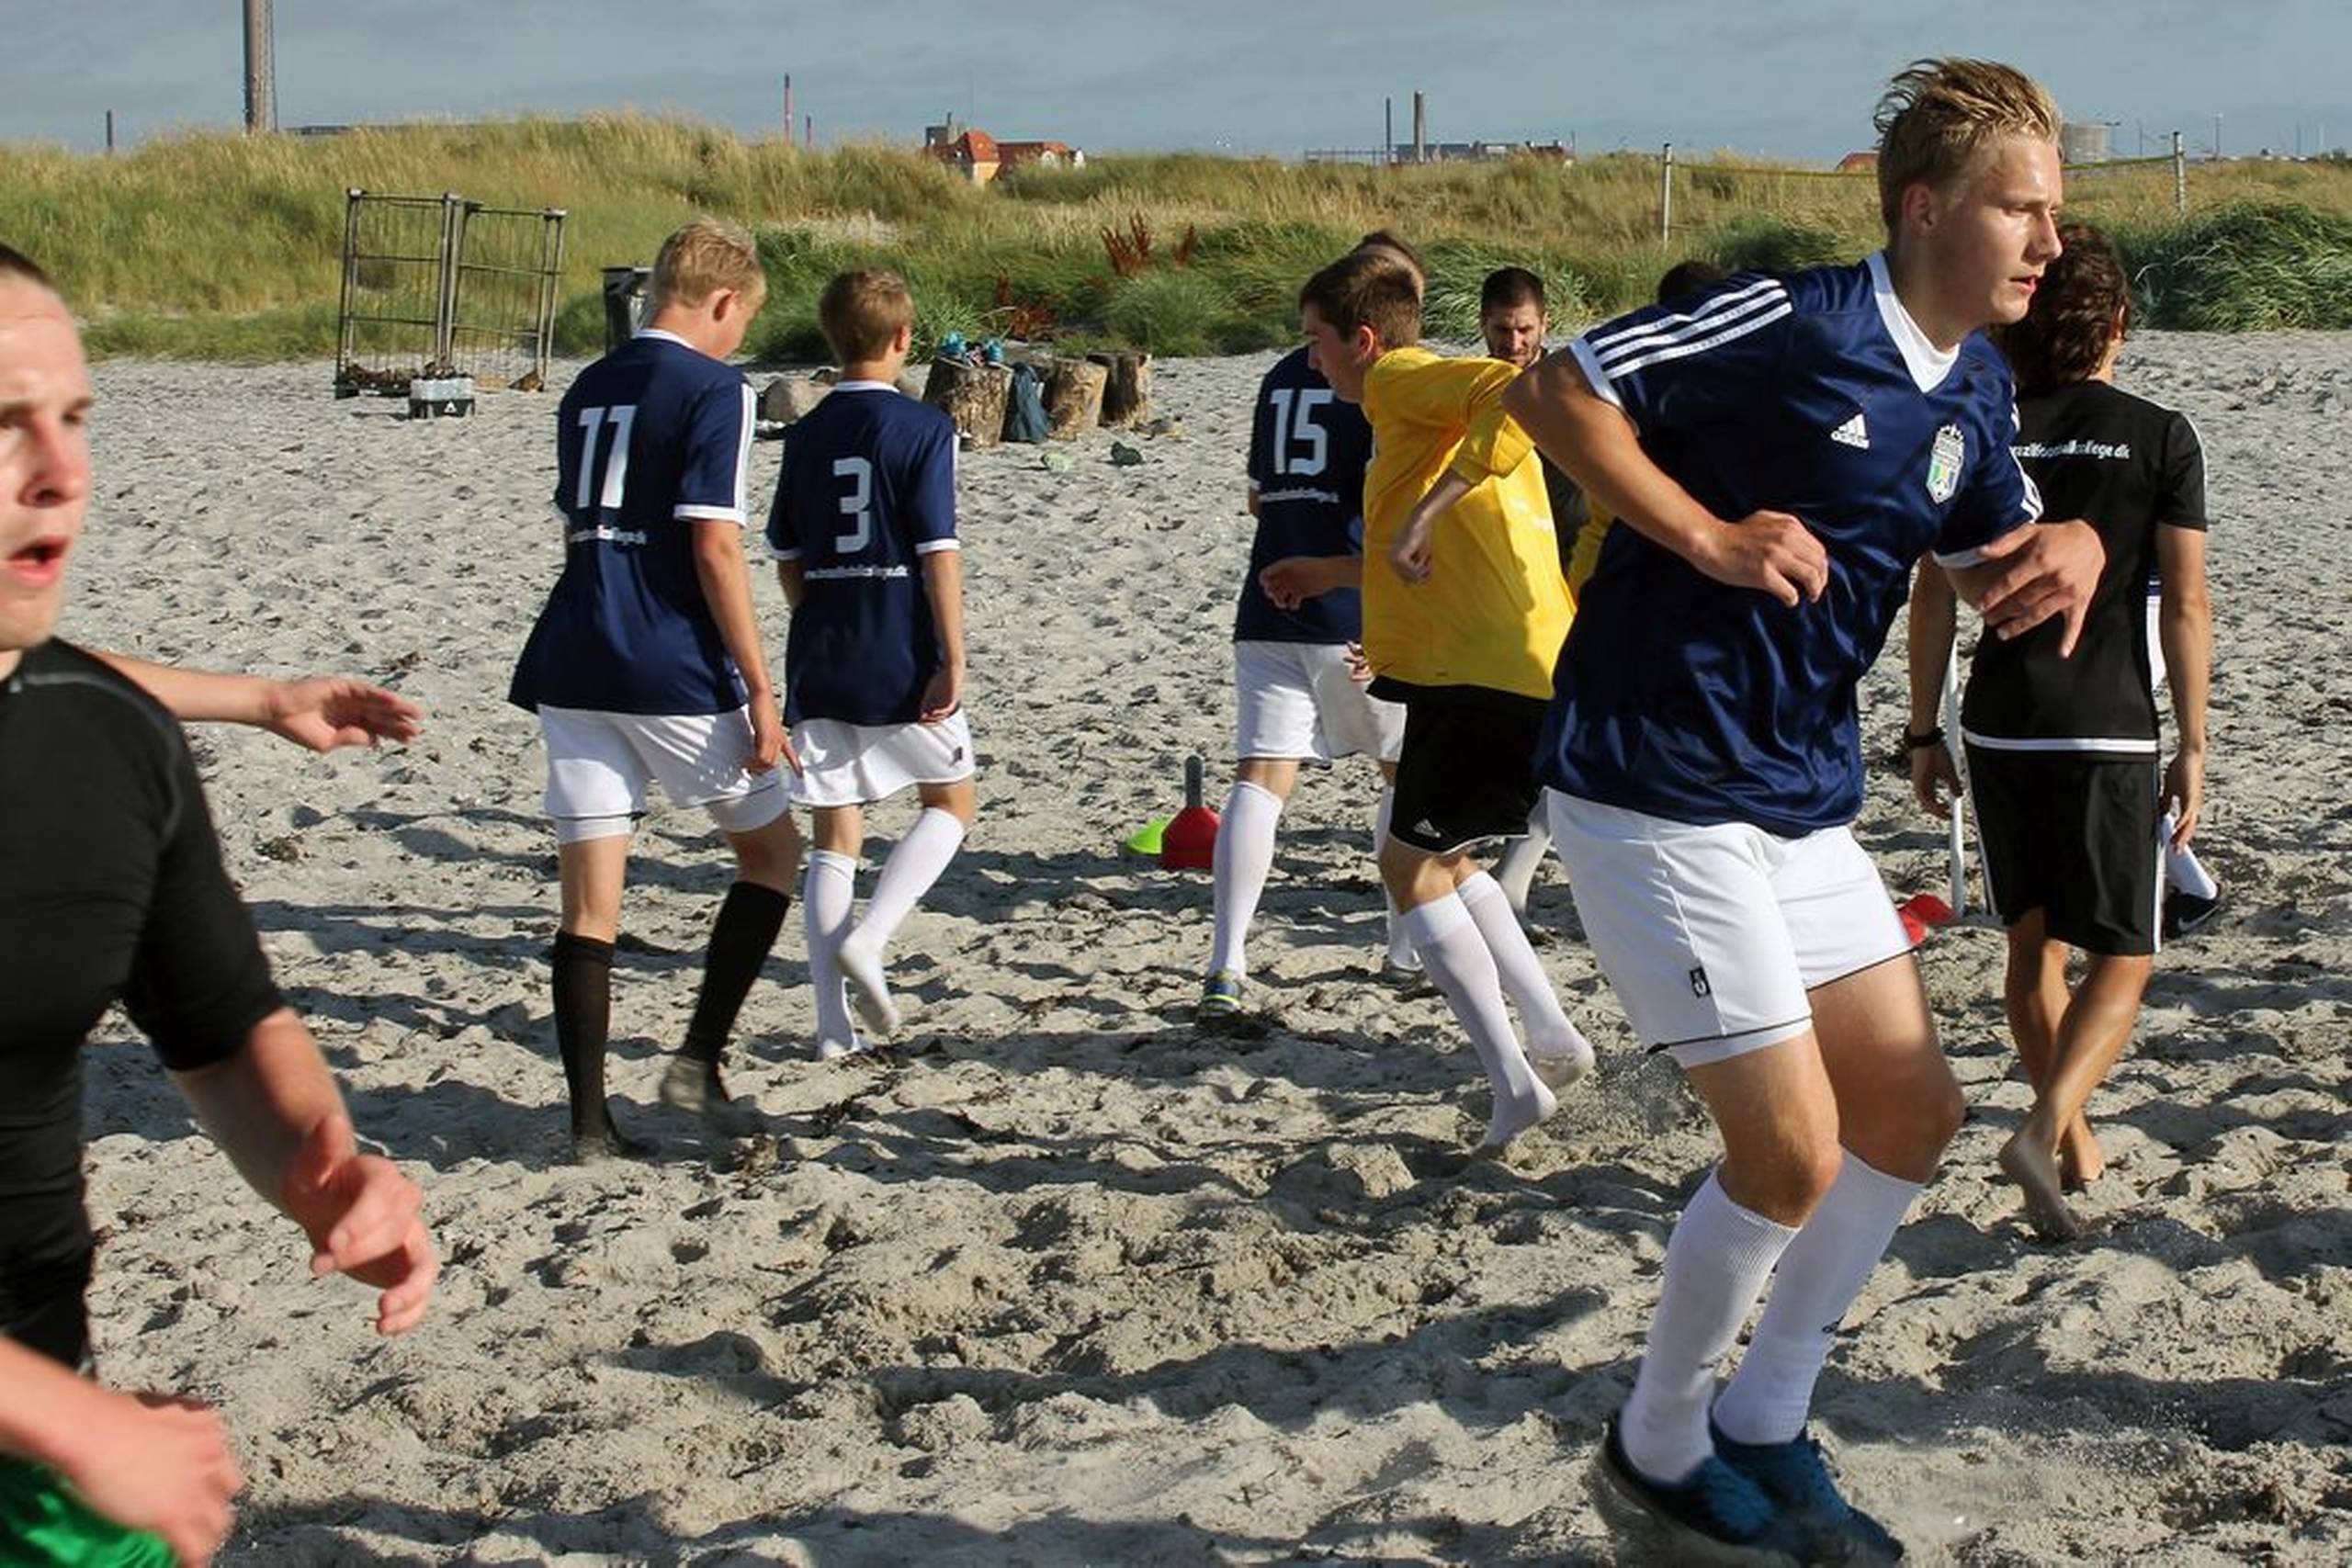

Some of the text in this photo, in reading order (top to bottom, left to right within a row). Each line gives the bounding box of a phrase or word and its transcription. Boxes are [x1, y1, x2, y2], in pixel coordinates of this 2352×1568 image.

[577, 405, 637, 508] 11
[1271, 388, 1333, 476] 15
[834, 457, 871, 553] 3
